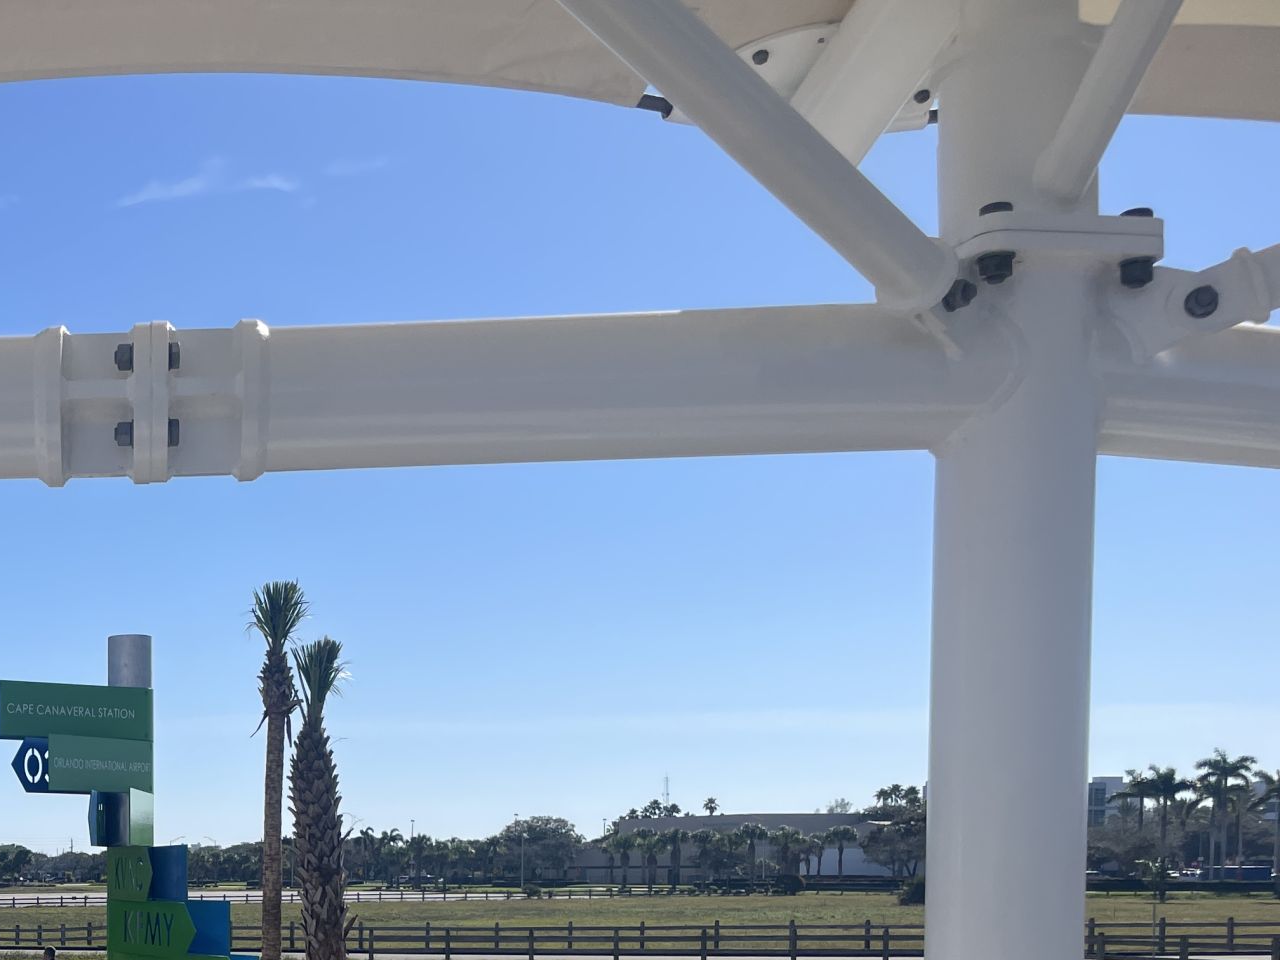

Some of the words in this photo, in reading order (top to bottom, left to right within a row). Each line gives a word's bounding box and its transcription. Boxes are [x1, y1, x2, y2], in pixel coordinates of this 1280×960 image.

[6, 702, 34, 715] CAPE
[36, 704, 96, 718] CANAVERAL
[98, 706, 135, 719] STATION
[53, 756, 84, 770] ORLANDO
[85, 758, 128, 772] INTERNATIONAL
[128, 761, 151, 773] AIRPORT
